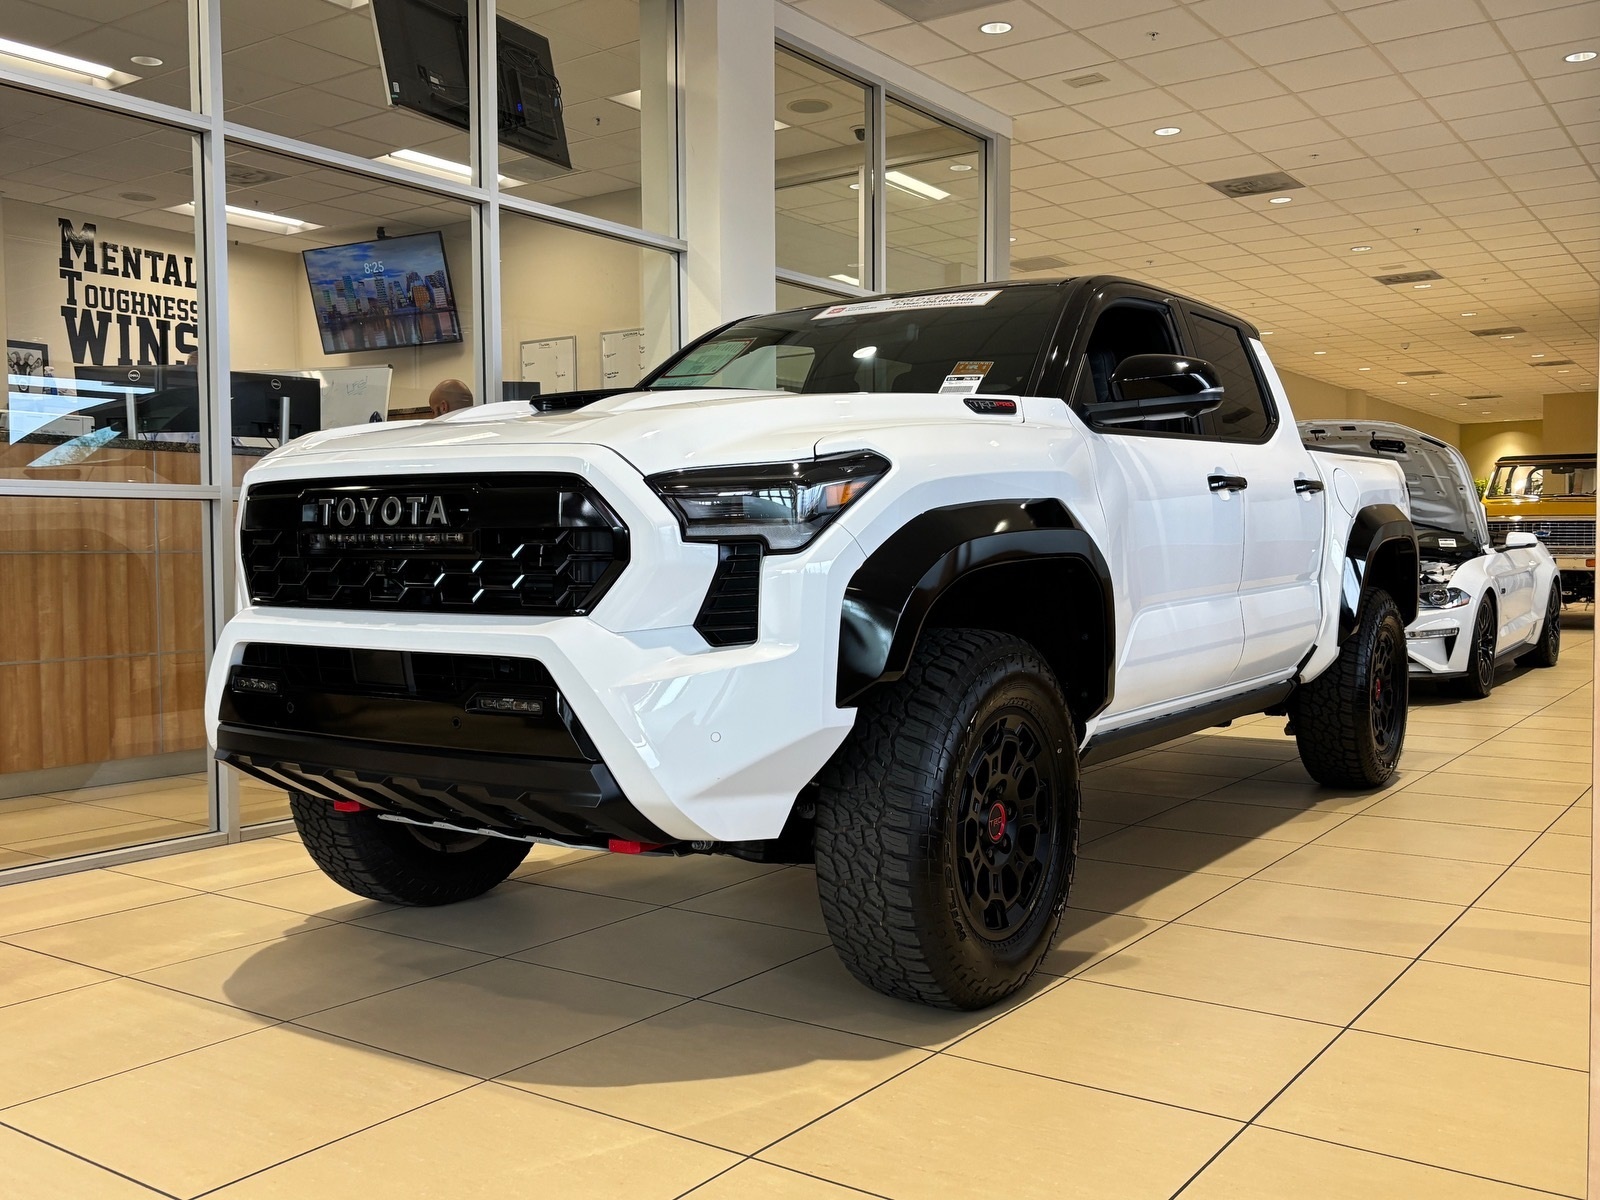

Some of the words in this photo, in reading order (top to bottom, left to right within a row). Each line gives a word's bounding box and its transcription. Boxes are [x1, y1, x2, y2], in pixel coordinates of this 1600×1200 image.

[58, 218, 197, 289] MENTAL
[363, 260, 385, 274] 8:25
[60, 268, 198, 323] TOUGHNESS
[926, 292, 989, 302] CERTIFIED
[61, 306, 198, 366] WINS
[318, 495, 448, 527] TOYOTA
